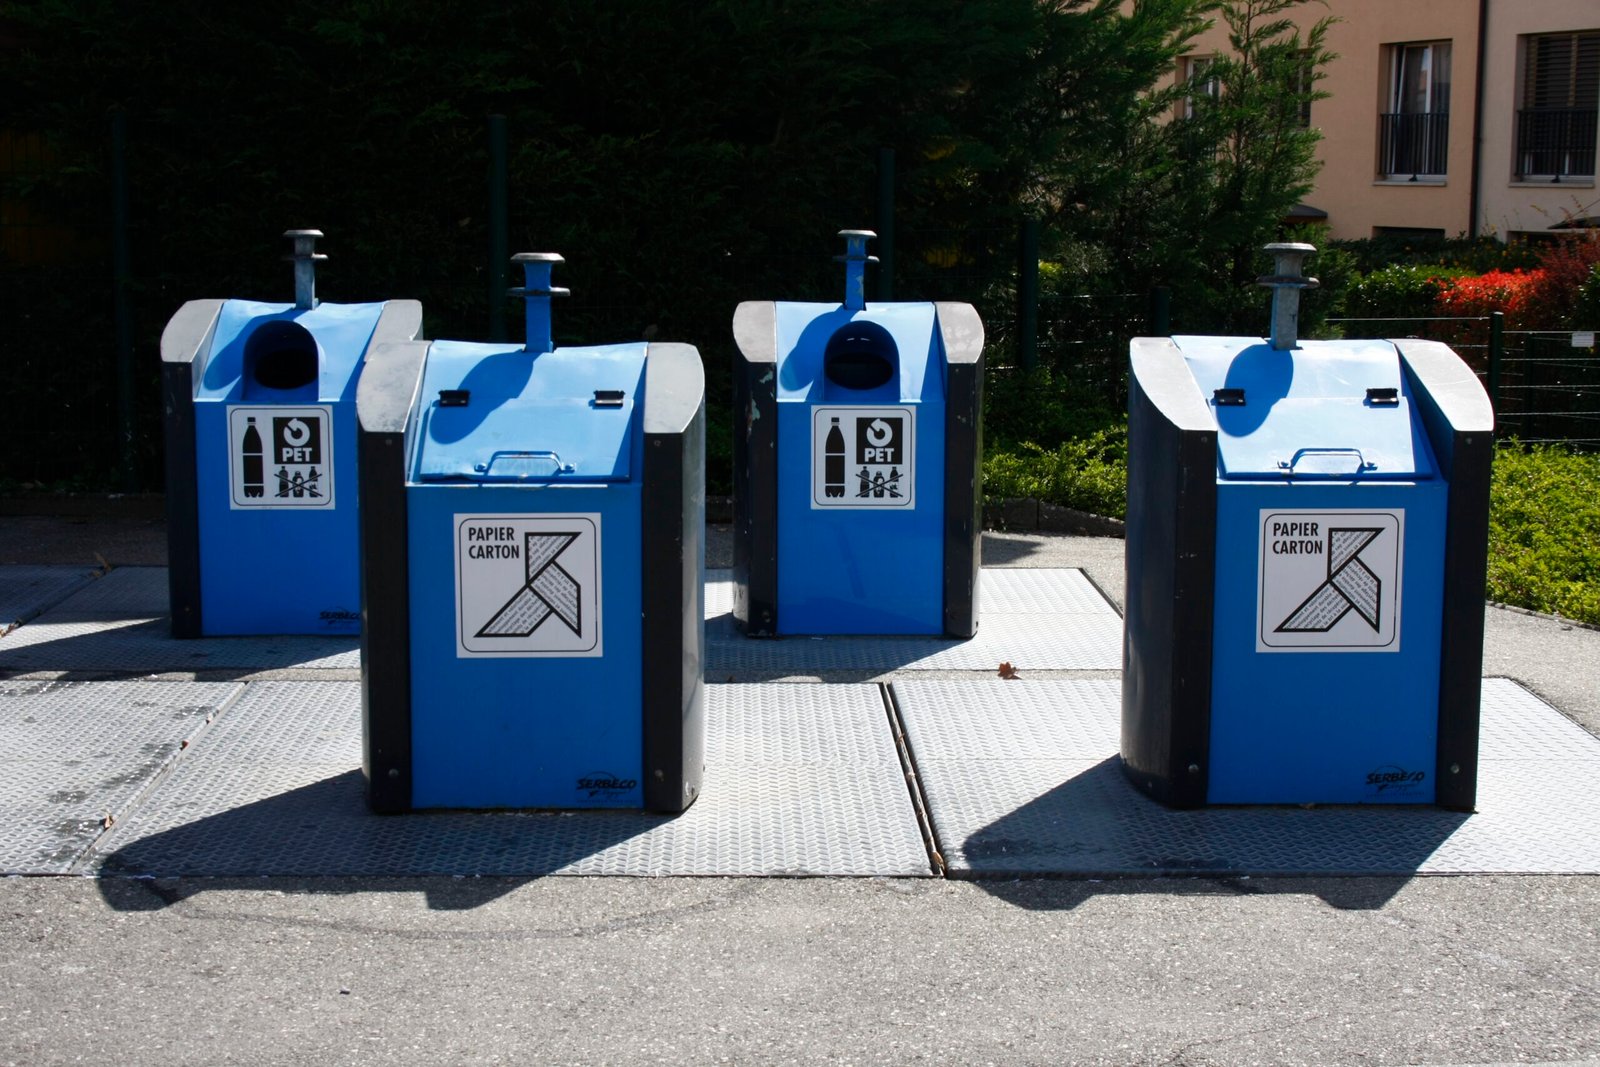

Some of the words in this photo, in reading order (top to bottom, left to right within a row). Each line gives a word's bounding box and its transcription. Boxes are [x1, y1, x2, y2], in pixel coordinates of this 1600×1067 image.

[282, 447, 312, 462] PET
[864, 447, 895, 462] PET
[468, 527, 515, 541] PAPIER
[1273, 522, 1319, 536] PAPIER
[468, 545, 520, 559] CARTON
[1272, 540, 1323, 554] CARTON
